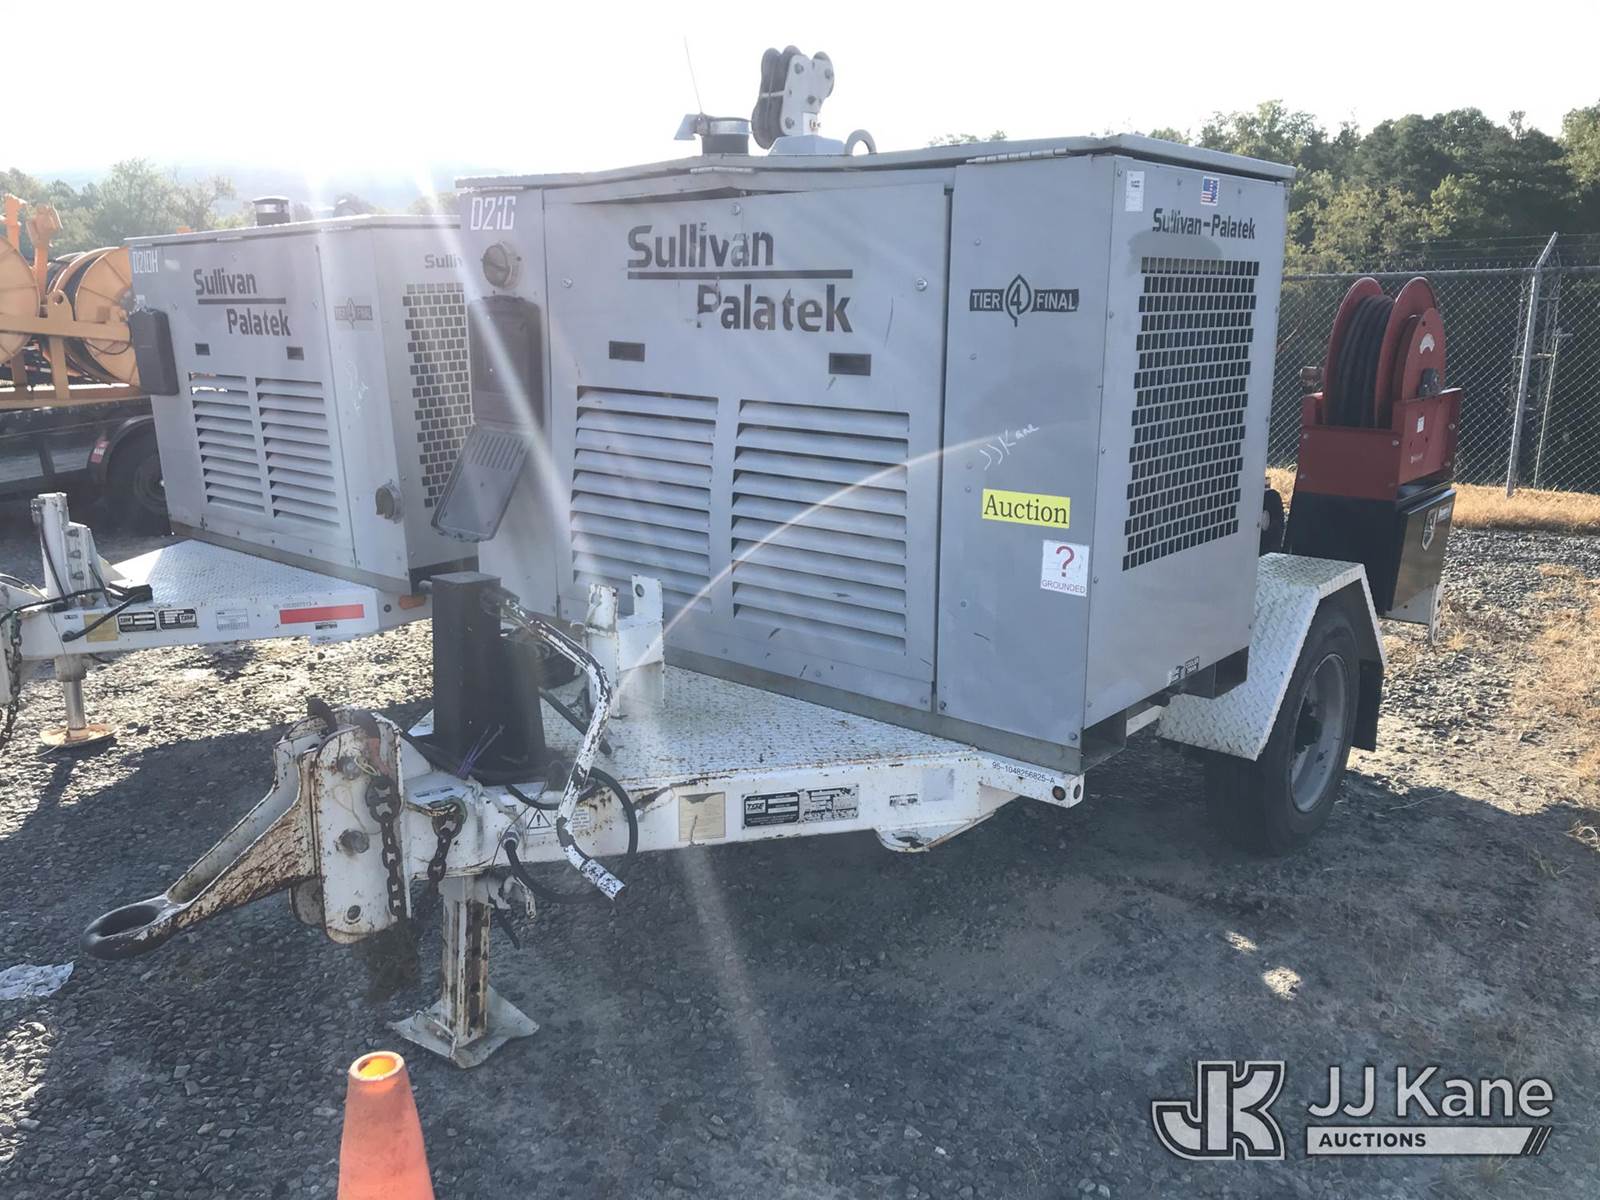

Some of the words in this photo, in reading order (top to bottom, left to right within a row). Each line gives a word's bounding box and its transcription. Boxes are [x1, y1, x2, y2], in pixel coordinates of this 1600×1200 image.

[1152, 208, 1256, 240] Sullivan-Palatek
[628, 222, 774, 269] Sullivan
[193, 268, 257, 296] Sullivan
[697, 284, 853, 333] Palatek
[971, 291, 1001, 309] TIER
[1010, 283, 1022, 316] 4
[1036, 292, 1077, 310] FINAL
[227, 308, 292, 336] Palatek
[983, 494, 1068, 525] Auction
[1041, 579, 1086, 595] GROUNDED
